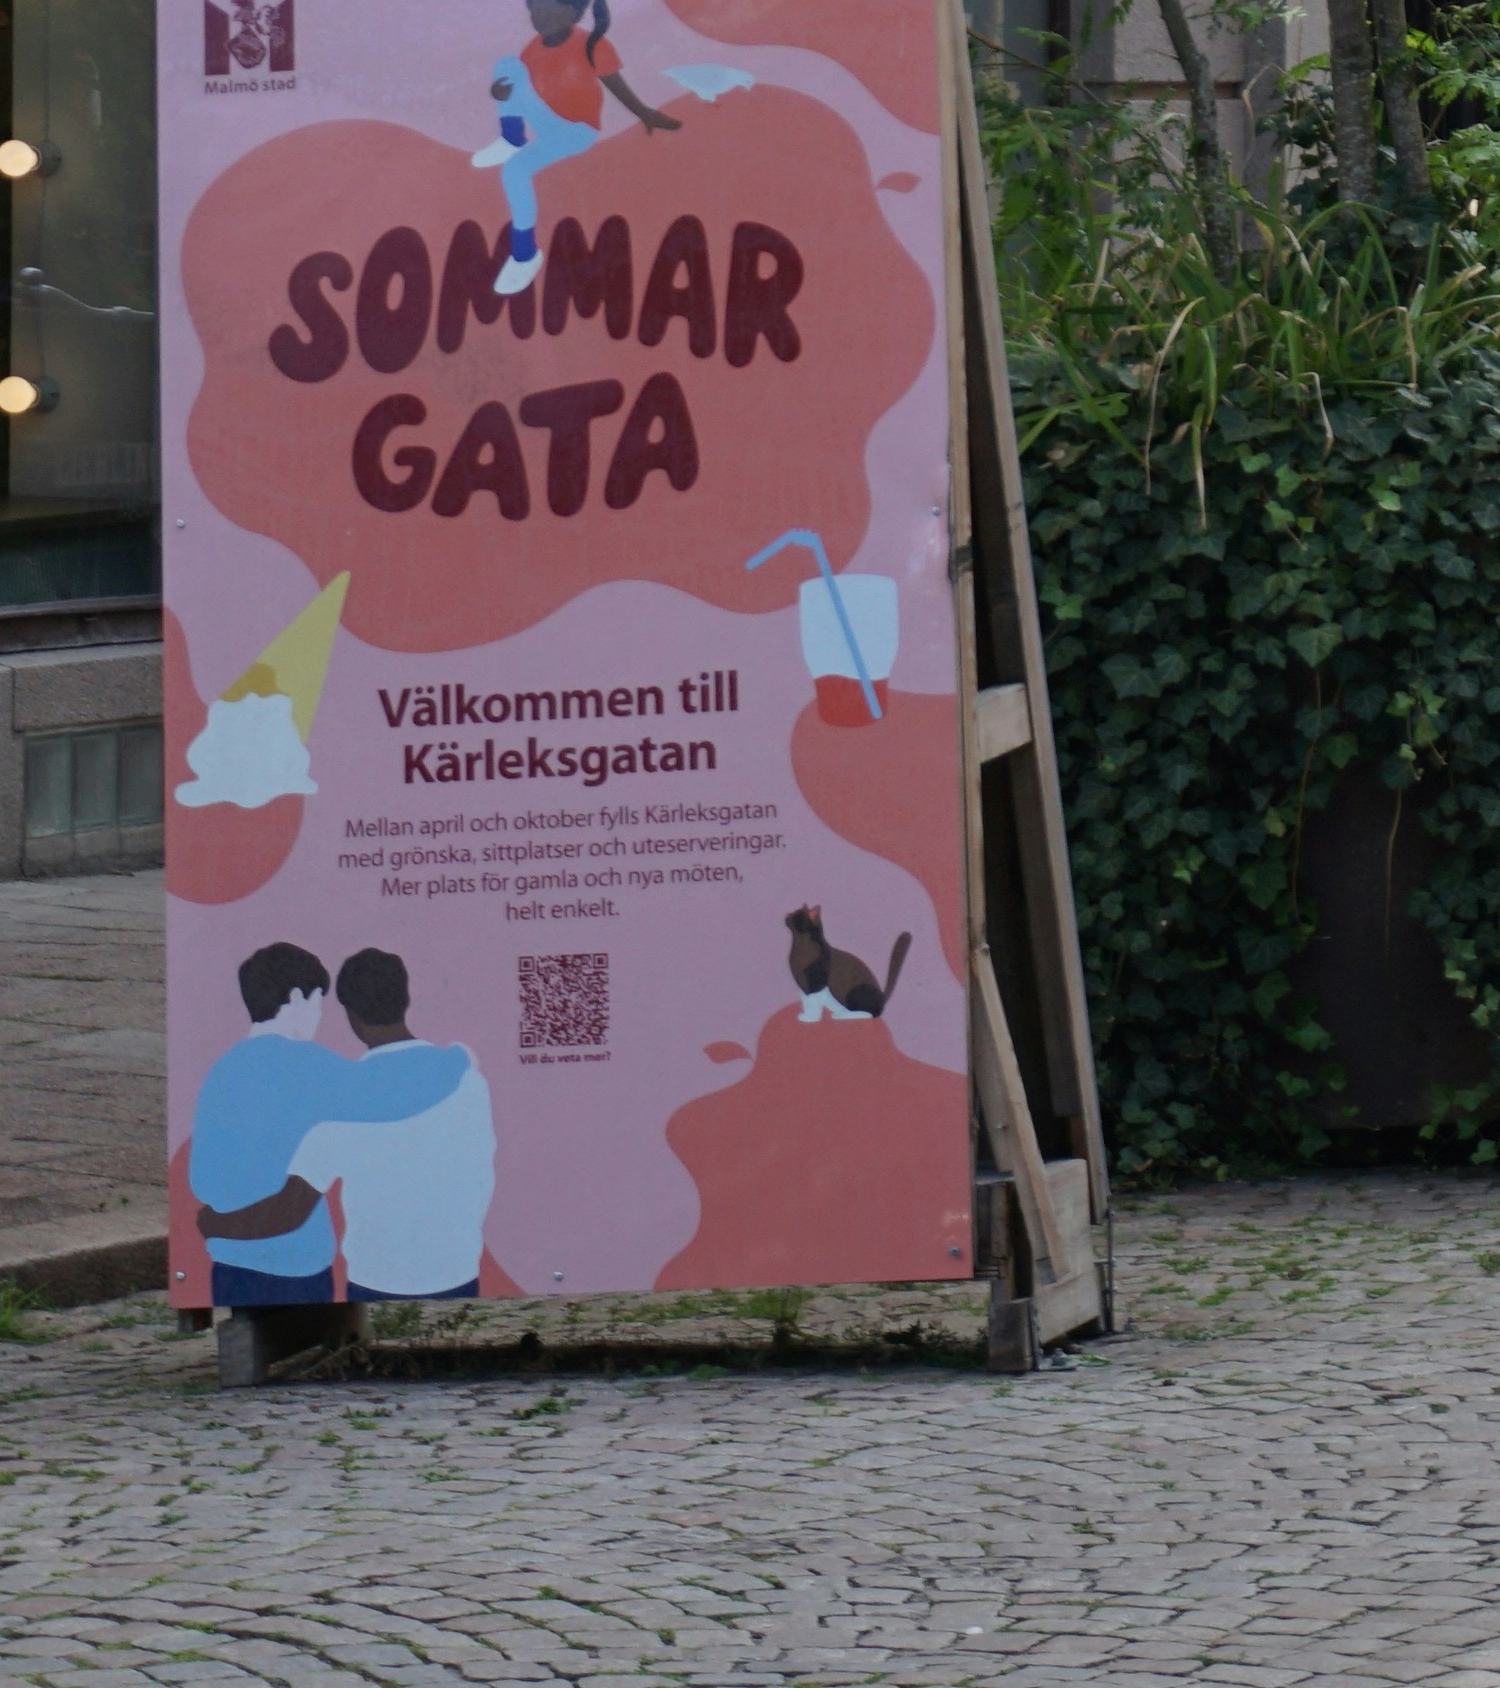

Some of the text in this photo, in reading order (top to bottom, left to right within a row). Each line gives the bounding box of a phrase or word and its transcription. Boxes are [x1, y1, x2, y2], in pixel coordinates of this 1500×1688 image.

[204, 76, 296, 94] Malmö stad
[269, 214, 804, 383] SOMMAR
[352, 372, 698, 521] GATA
[378, 670, 739, 728] Välkommen till
[404, 737, 718, 788] Kärleksgatan
[345, 801, 778, 840] Mellan april och oktober fylls Kärleksgatan
[338, 831, 787, 872] med grönska, sittplatser och uteserveringar.
[381, 863, 744, 899] Mer plats för gamla och nya möten,
[505, 897, 620, 922] helt enkelt.
[541, 1053, 555, 1063] du
